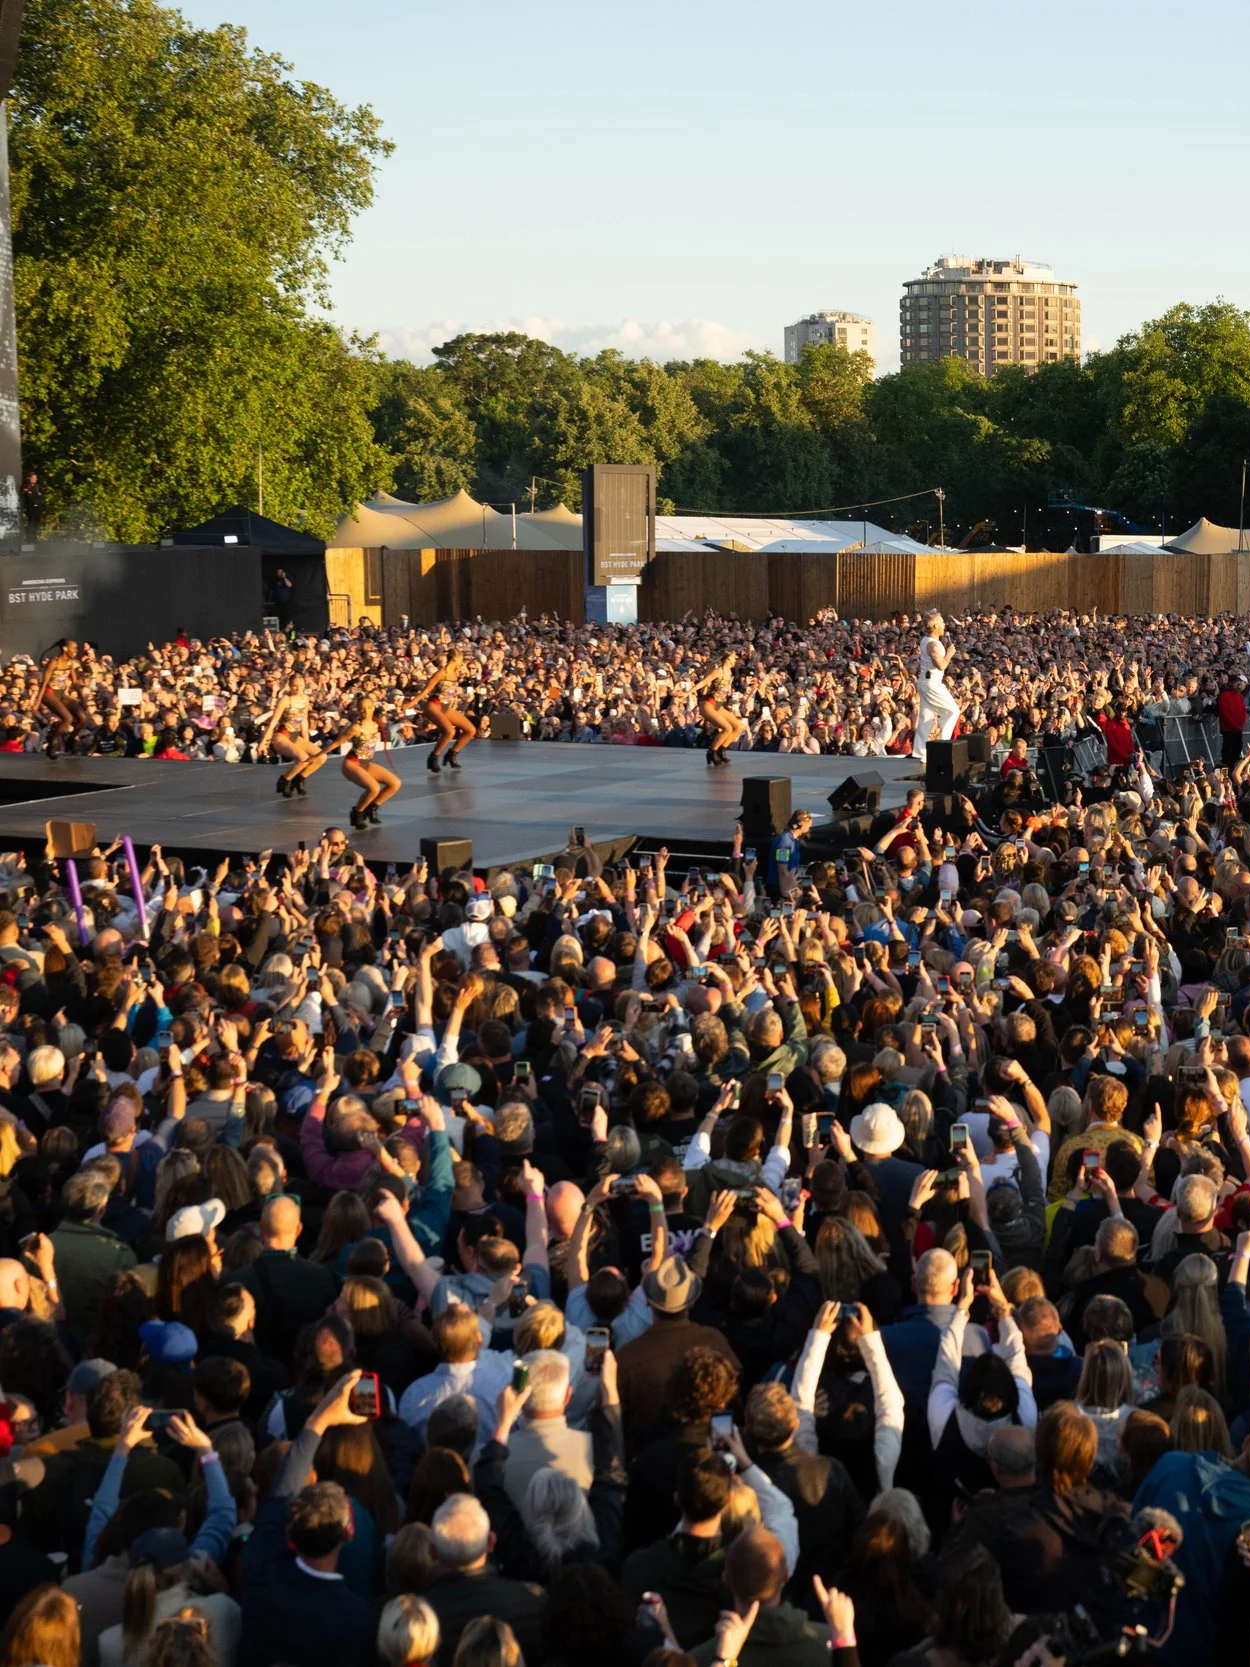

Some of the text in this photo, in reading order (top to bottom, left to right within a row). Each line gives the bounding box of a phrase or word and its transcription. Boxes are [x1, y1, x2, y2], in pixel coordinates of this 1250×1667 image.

[630, 560, 645, 568] PARK
[8, 590, 79, 603] BST HYDE PARK
